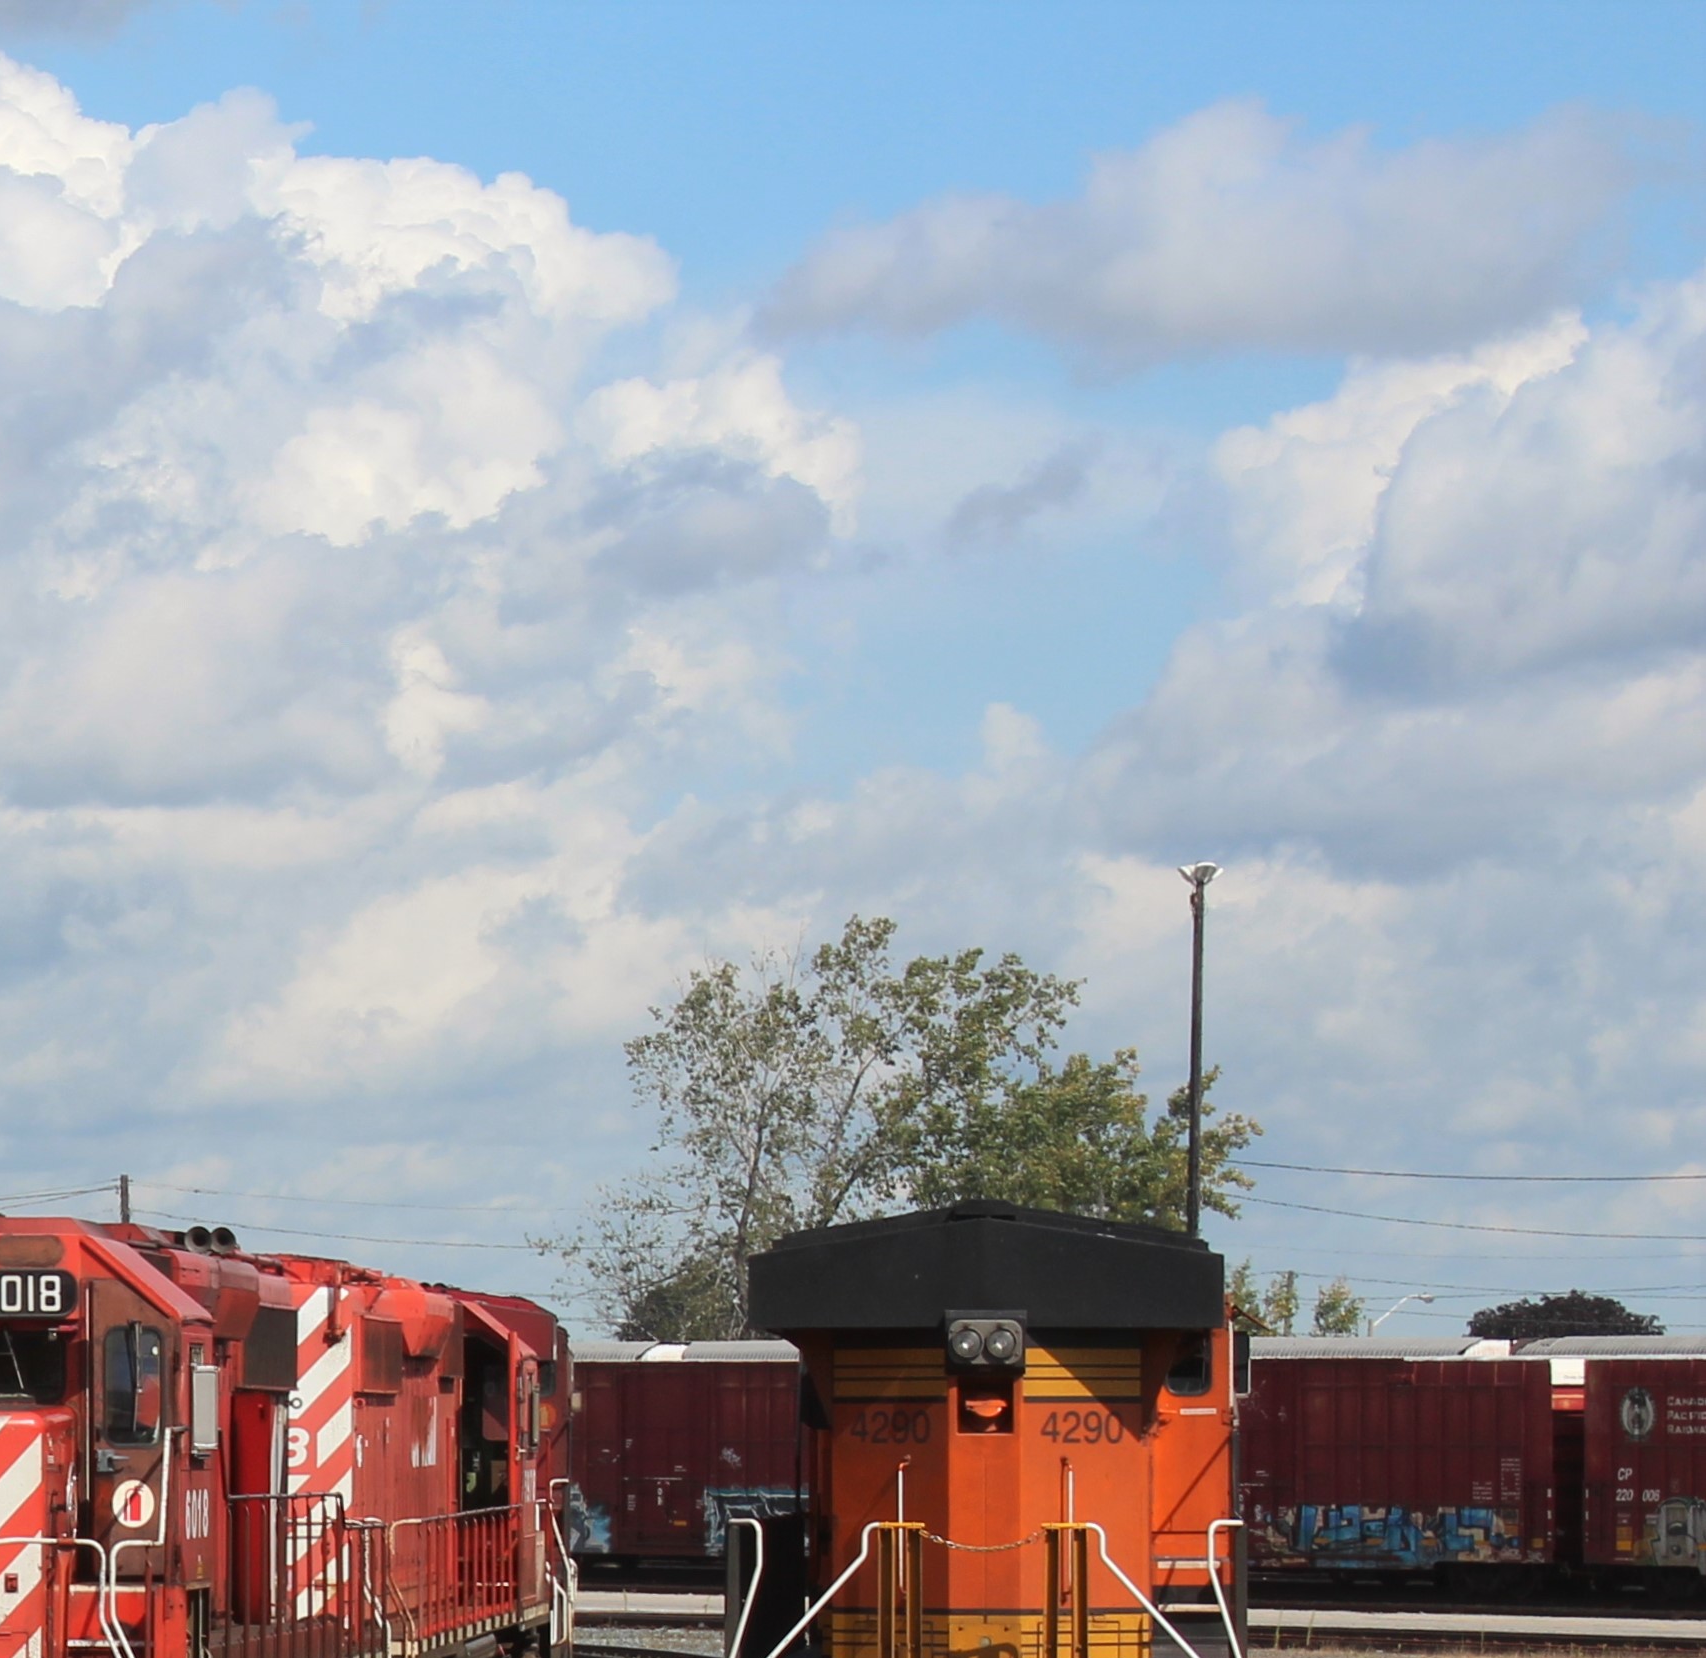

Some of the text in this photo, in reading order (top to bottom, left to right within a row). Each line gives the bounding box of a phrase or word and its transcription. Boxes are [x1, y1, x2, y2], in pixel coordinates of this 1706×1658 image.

[850, 1410, 931, 1444] 4290
[1041, 1410, 1124, 1444] 4290
[1617, 1467, 1633, 1481] CP
[185, 1489, 210, 1539] 6018
